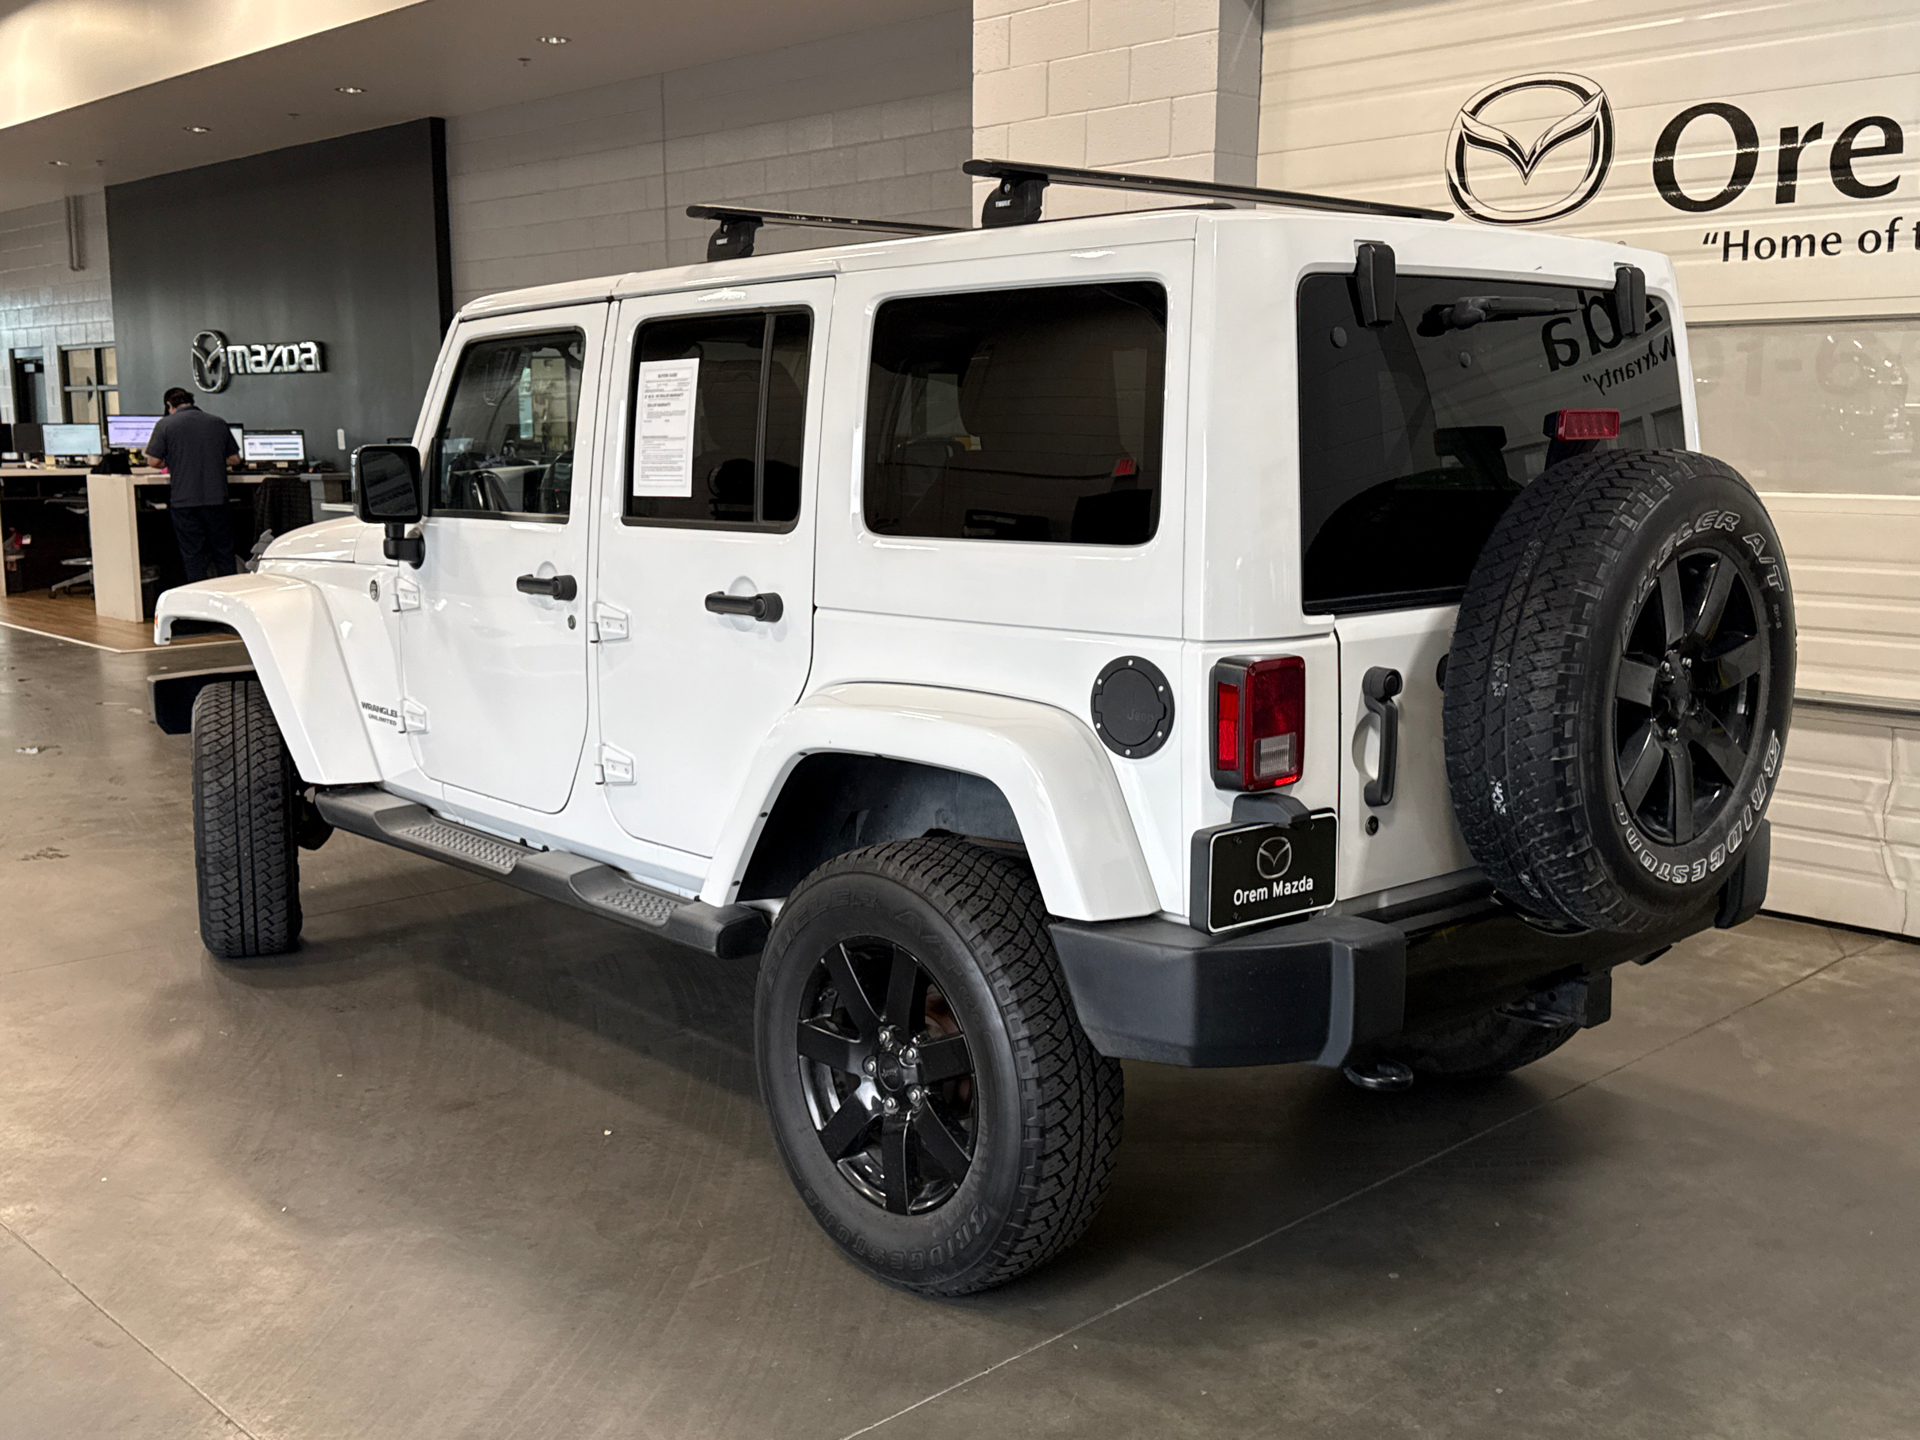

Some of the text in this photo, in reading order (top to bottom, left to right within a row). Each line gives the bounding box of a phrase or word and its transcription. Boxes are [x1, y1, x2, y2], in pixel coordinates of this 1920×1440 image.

[1652, 102, 1904, 213] Ore
[1702, 229, 1842, 262] “Home
[1857, 217, 1903, 254] of
[368, 713, 398, 727] UNLIMITED
[1127, 708, 1156, 725] Jeep
[1233, 875, 1314, 906] Orem Mazda
